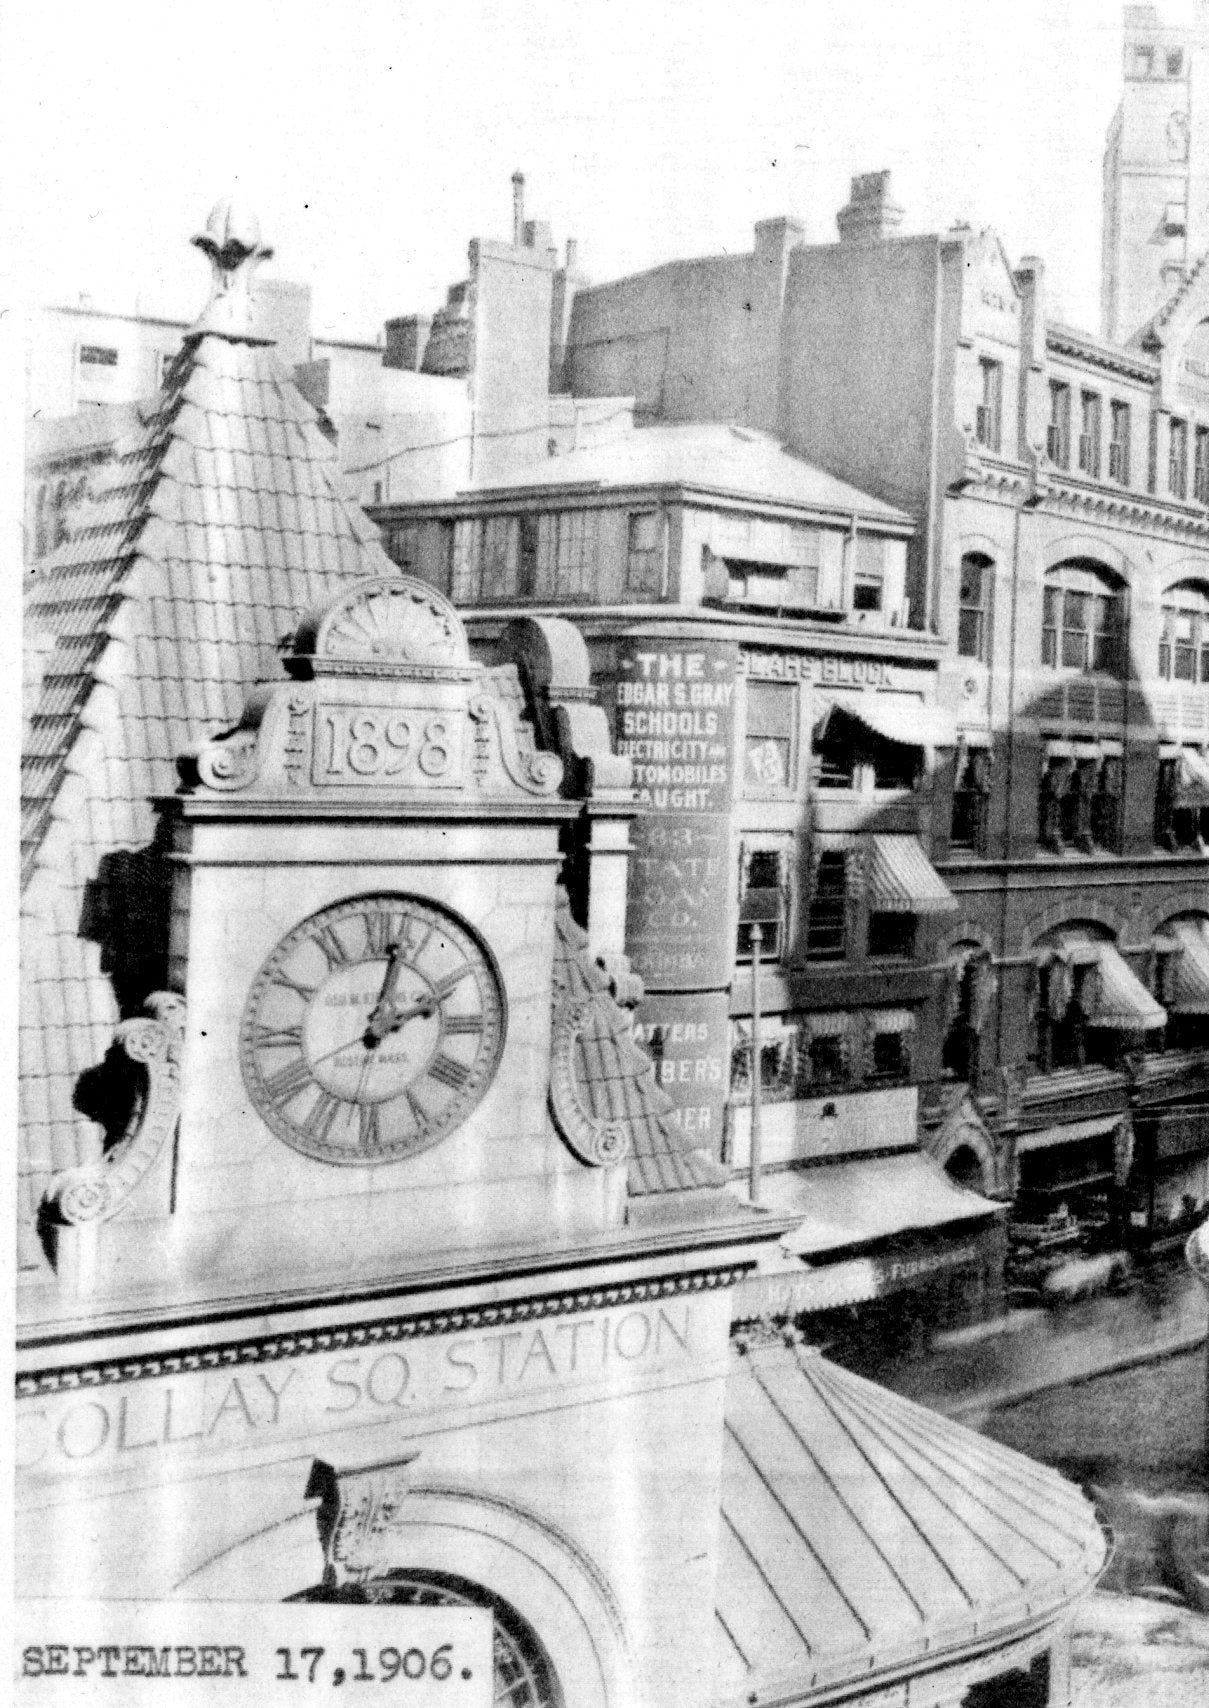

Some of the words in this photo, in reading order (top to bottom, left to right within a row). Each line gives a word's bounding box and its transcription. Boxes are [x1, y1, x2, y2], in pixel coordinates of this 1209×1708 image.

[637, 653, 706, 677] THE
[690, 682, 733, 707] GRAY
[624, 711, 718, 735] SCHOOLS
[326, 715, 450, 778] 1898
[632, 765, 727, 785] TOMOBILES
[633, 789, 714, 809] AUGHT.
[638, 857, 720, 877] TATE
[634, 1023, 708, 1043] ATTERS
[661, 1055, 723, 1084] BER'S
[325, 1352, 416, 1414] SQ.
[444, 1305, 692, 1393] STATION
